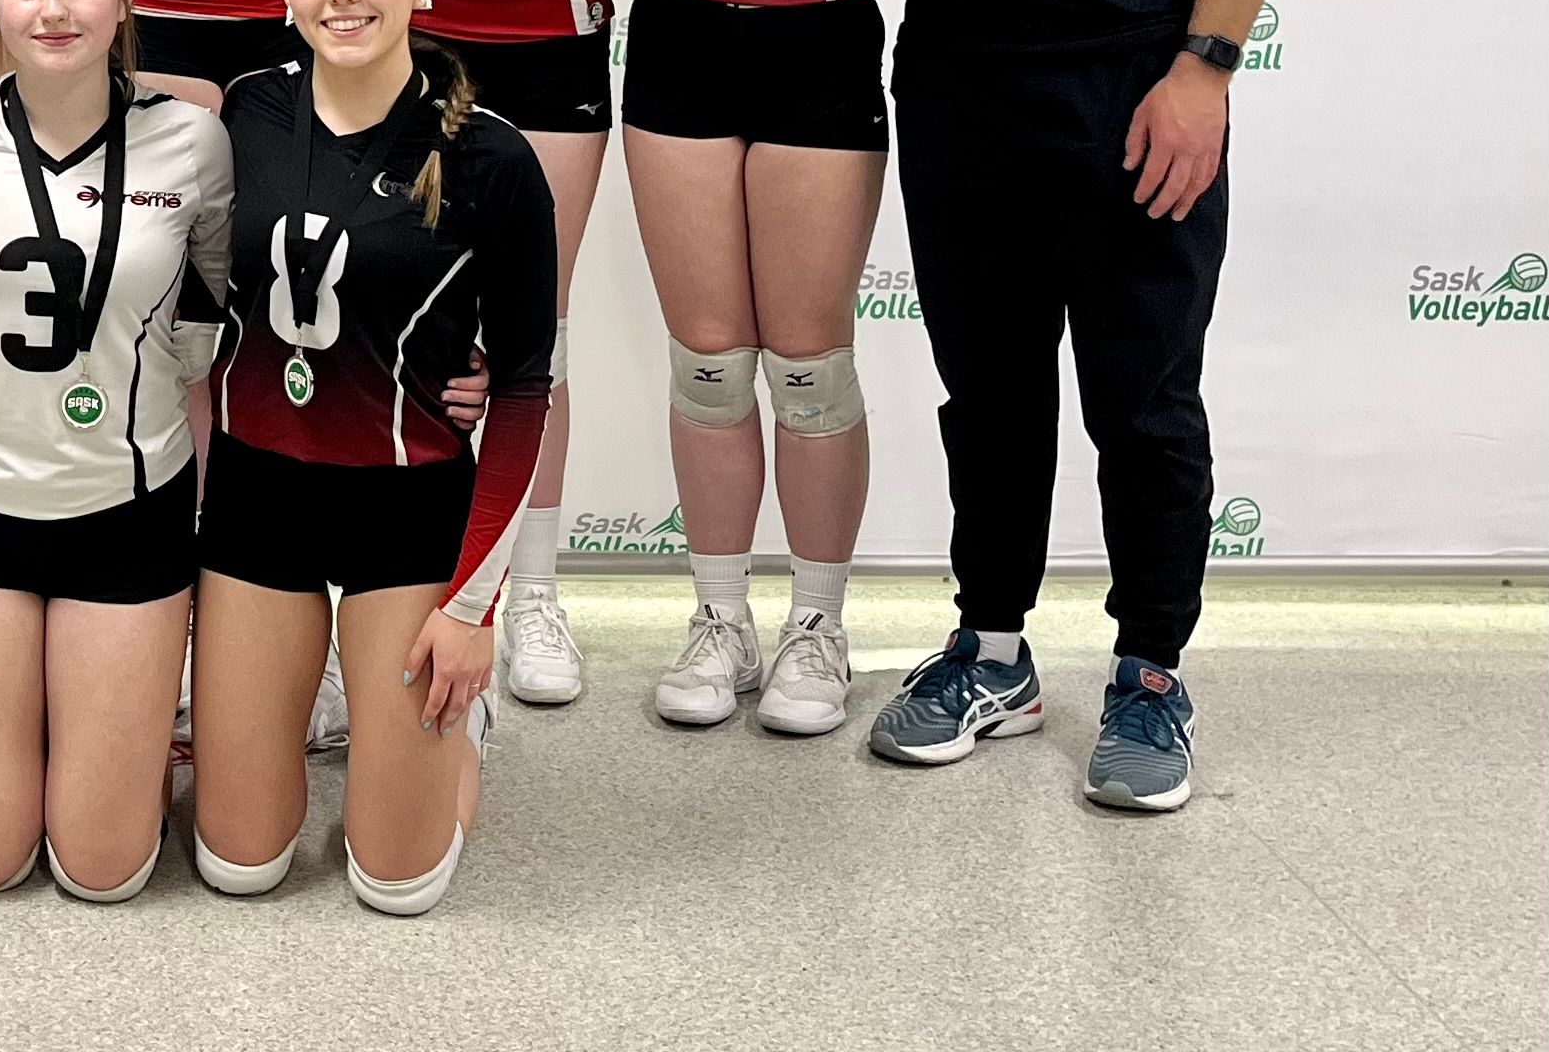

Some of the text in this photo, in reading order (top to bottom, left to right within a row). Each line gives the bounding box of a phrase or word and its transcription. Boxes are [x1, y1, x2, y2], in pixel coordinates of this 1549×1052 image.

[1409, 265, 1485, 291] Sask
[68, 396, 99, 410] SASK
[570, 512, 647, 534] Sask
